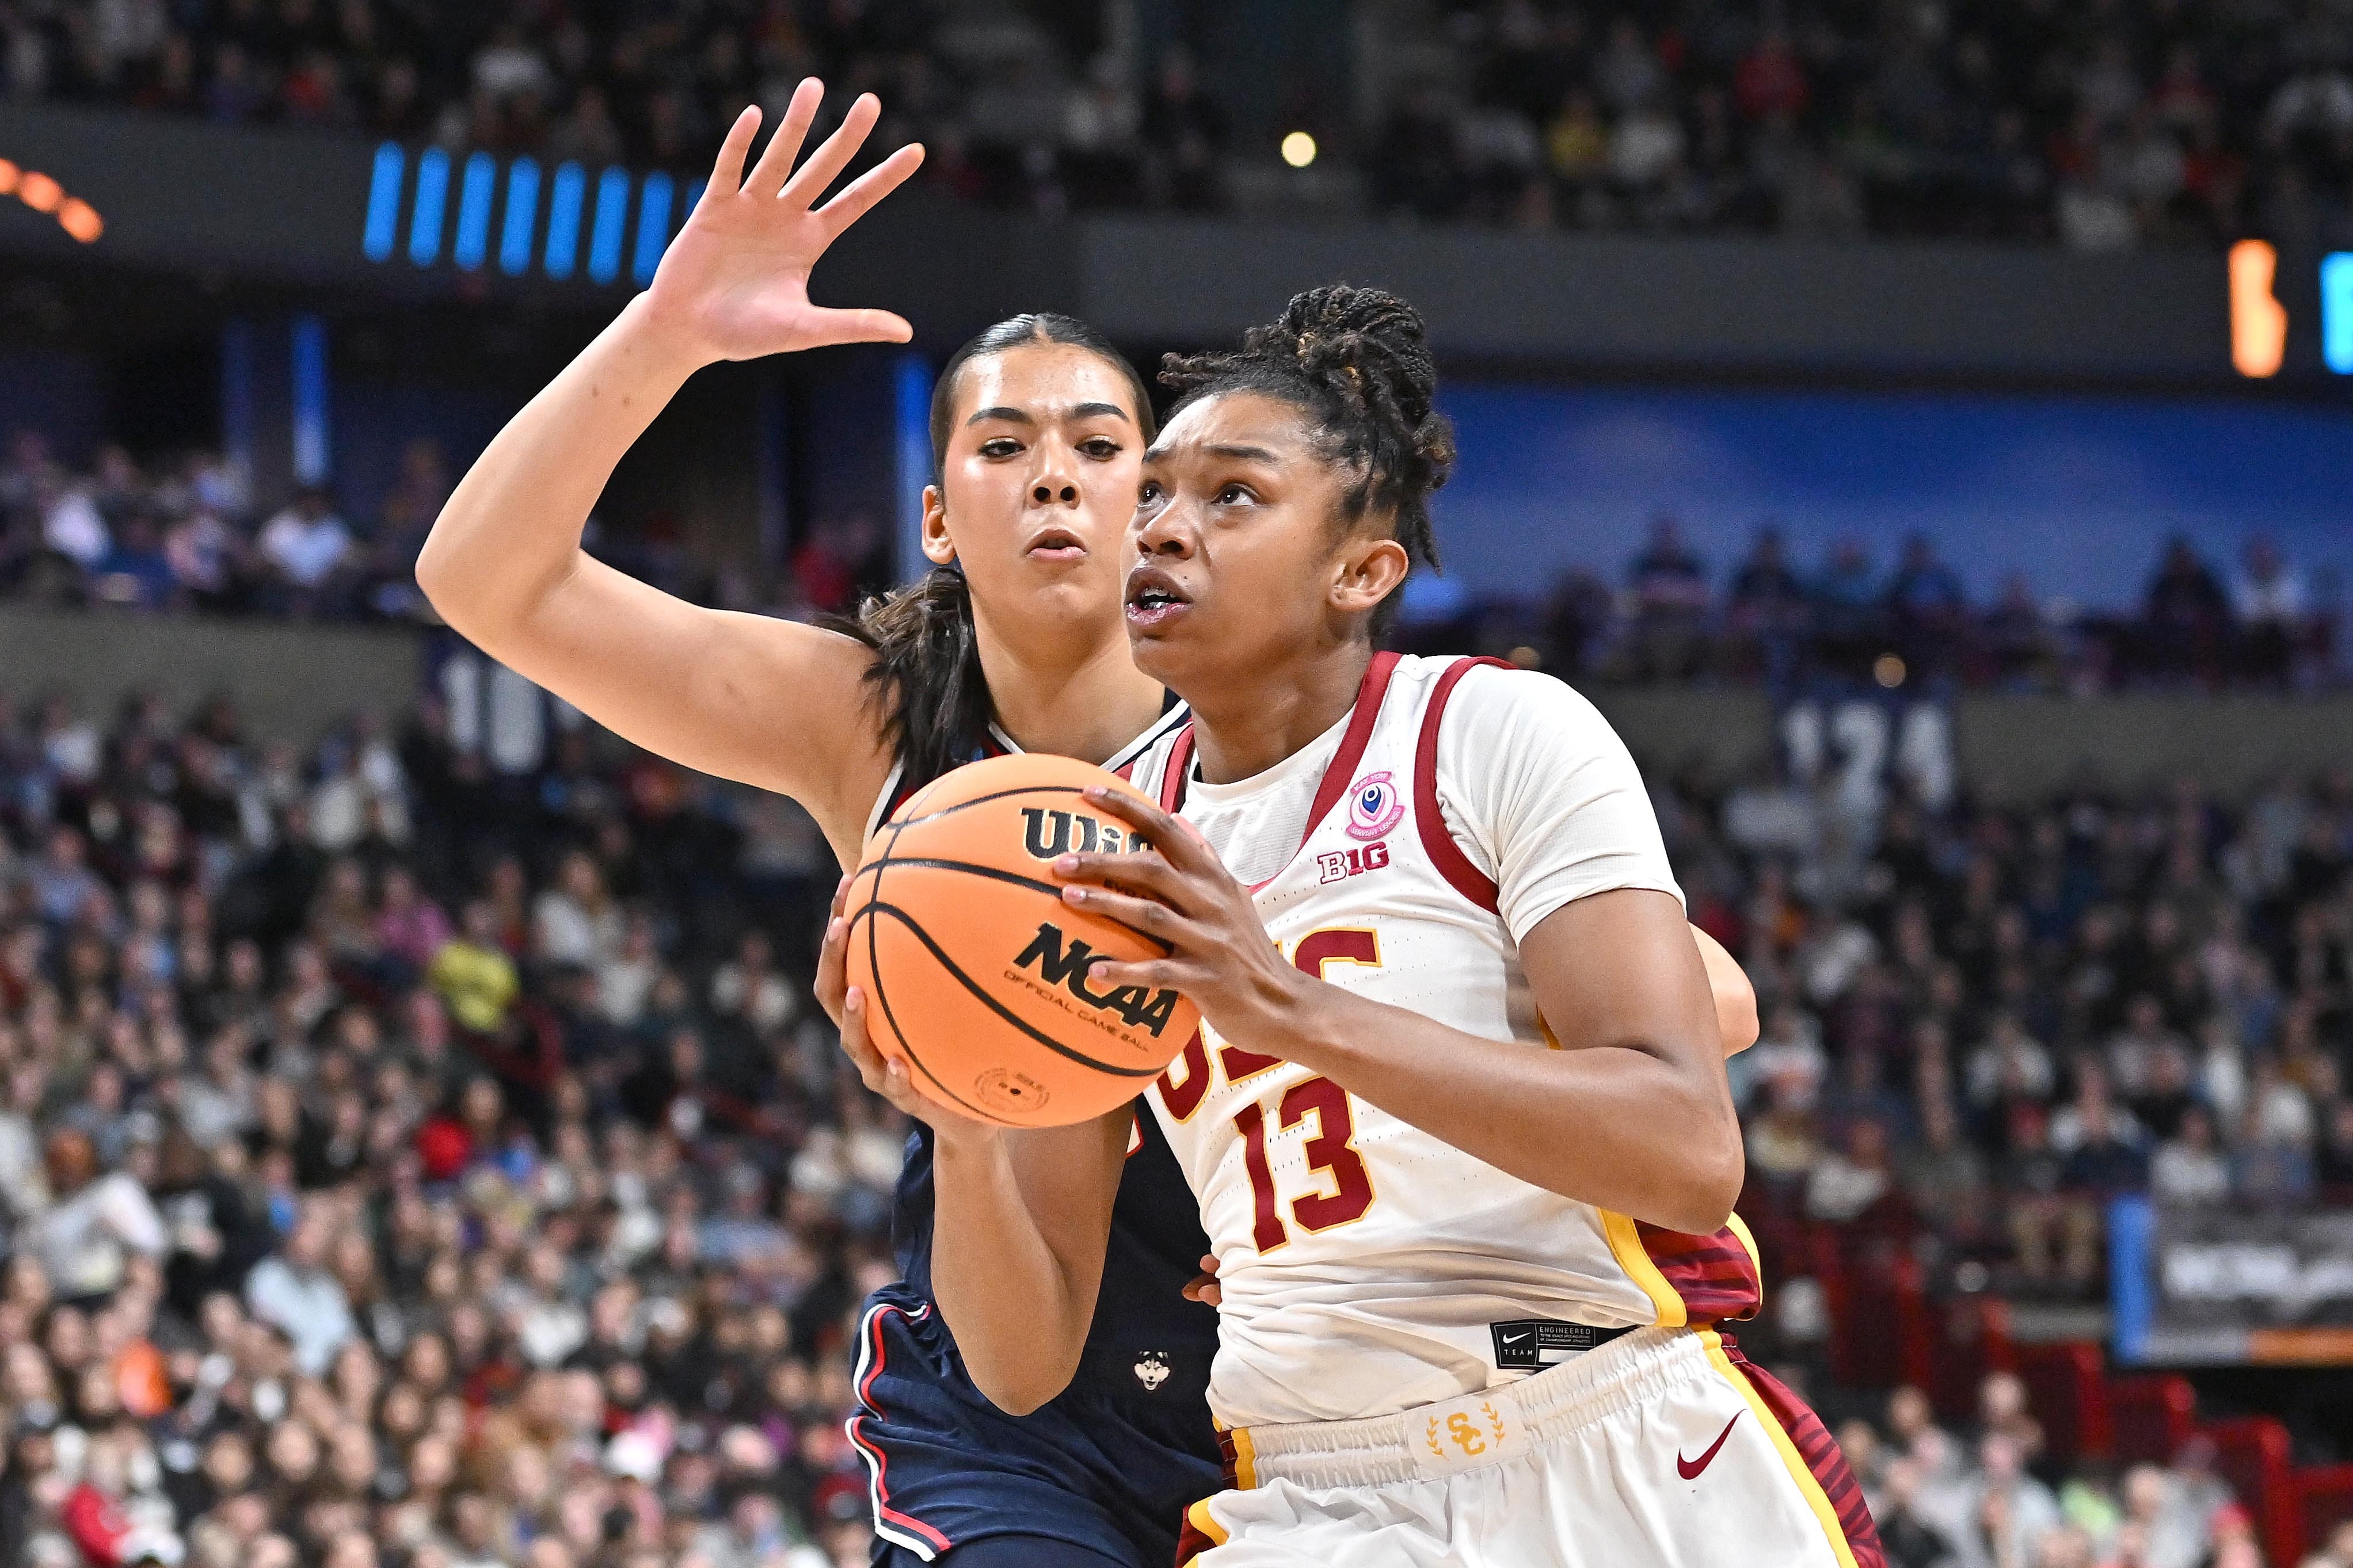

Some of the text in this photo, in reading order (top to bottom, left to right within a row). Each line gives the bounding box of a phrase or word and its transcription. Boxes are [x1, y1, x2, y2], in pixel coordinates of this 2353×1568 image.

[1003, 970, 1149, 1052] OFFICIAL GAME BALL
[1012, 921, 1179, 1038] NCAA
[1233, 1074, 1376, 1256] 13
[1539, 1326, 1590, 1334] ENGINEERED
